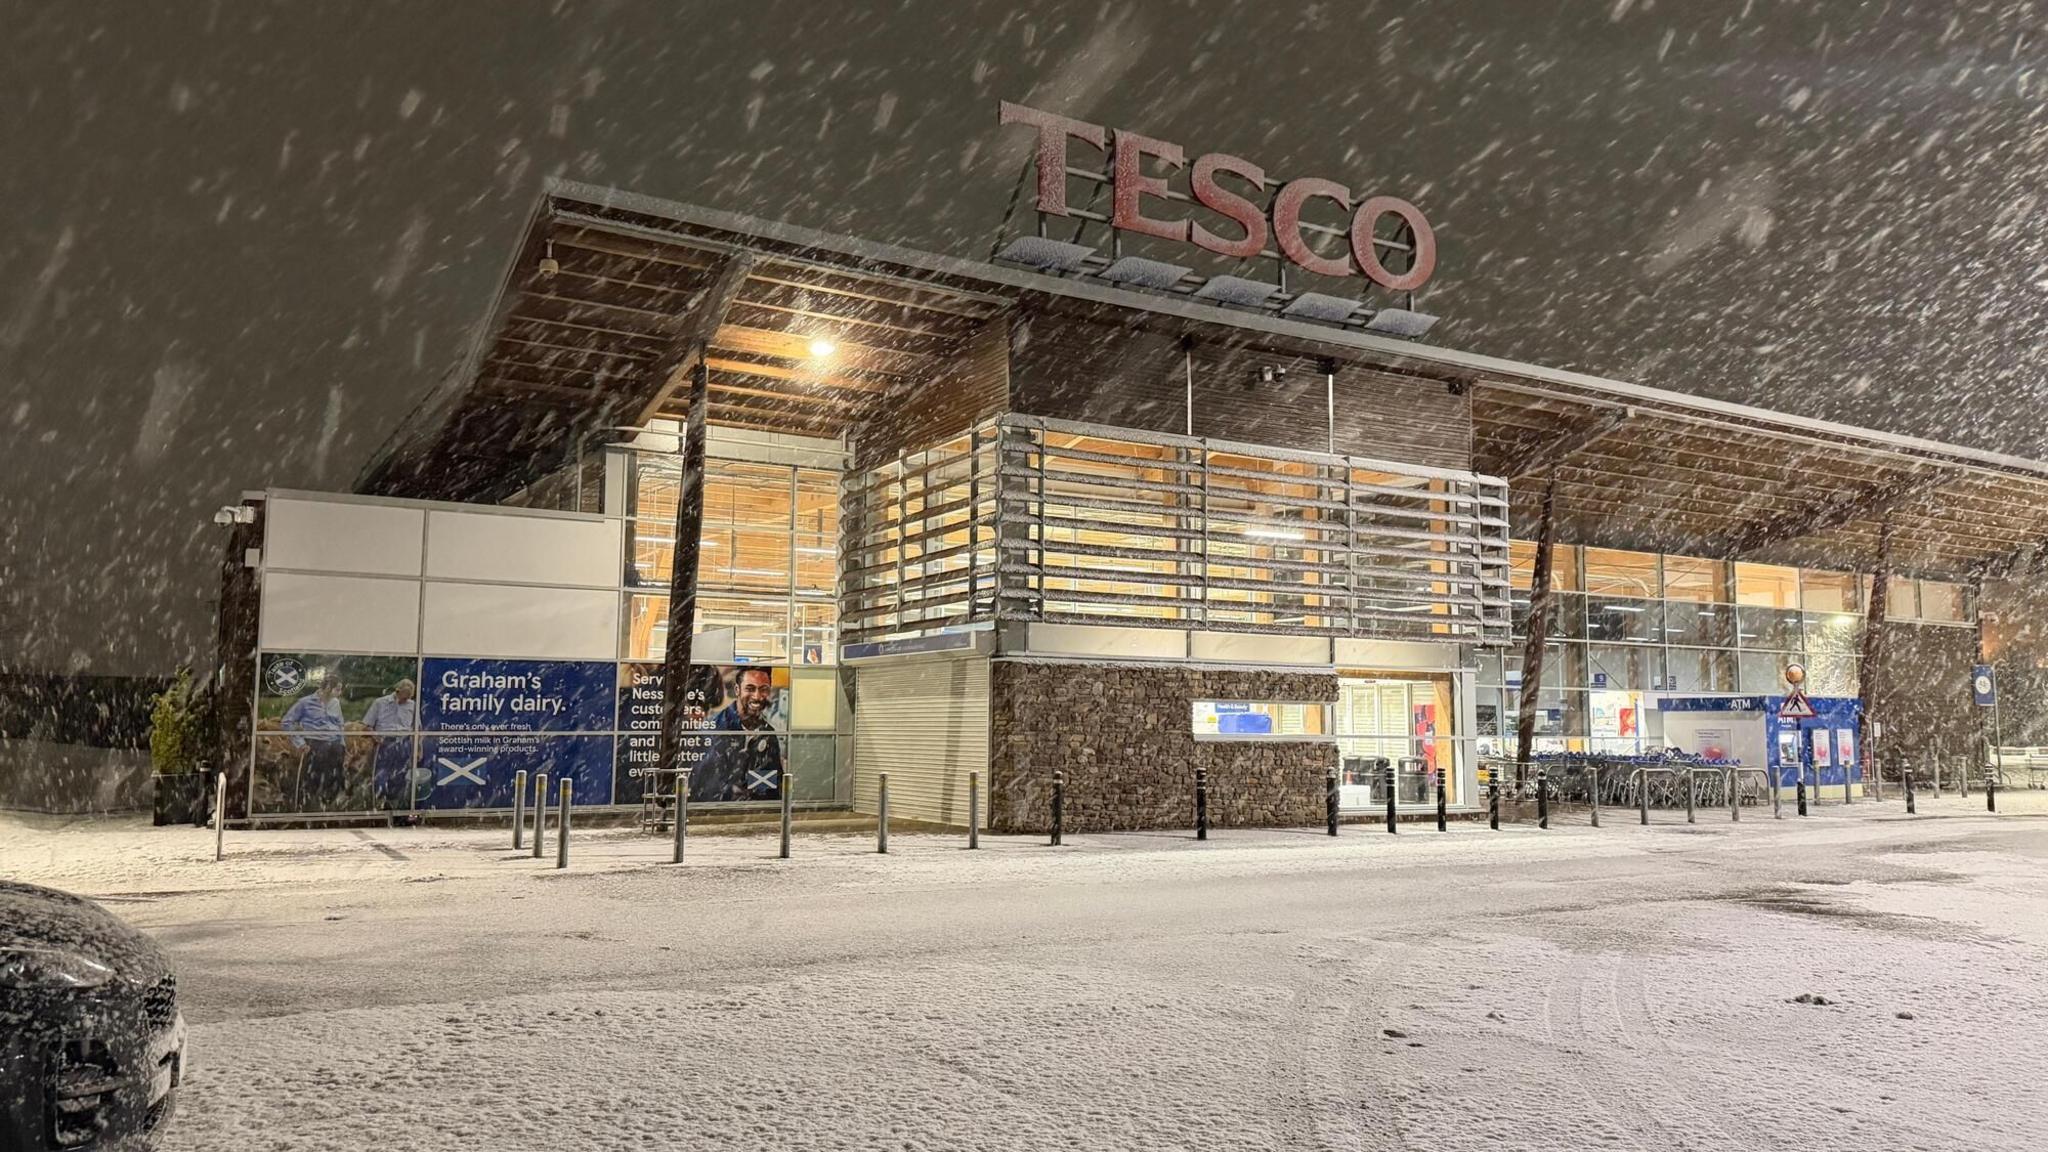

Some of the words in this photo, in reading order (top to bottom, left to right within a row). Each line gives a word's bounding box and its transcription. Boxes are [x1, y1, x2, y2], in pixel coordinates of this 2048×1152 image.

[1000, 101, 1437, 290] TESCO
[441, 671, 542, 689] Graham's
[440, 693, 504, 715] family
[510, 693, 567, 715] dairy.
[1730, 699, 1751, 709] ATM
[441, 722, 470, 730] There's
[471, 723, 488, 732] only
[439, 736, 472, 744] Scottish
[474, 736, 492, 744] milk
[493, 736, 501, 744] in
[629, 736, 655, 747] and
[704, 737, 712, 747] a
[438, 746, 499, 756] award-winning
[629, 750, 660, 762] little
